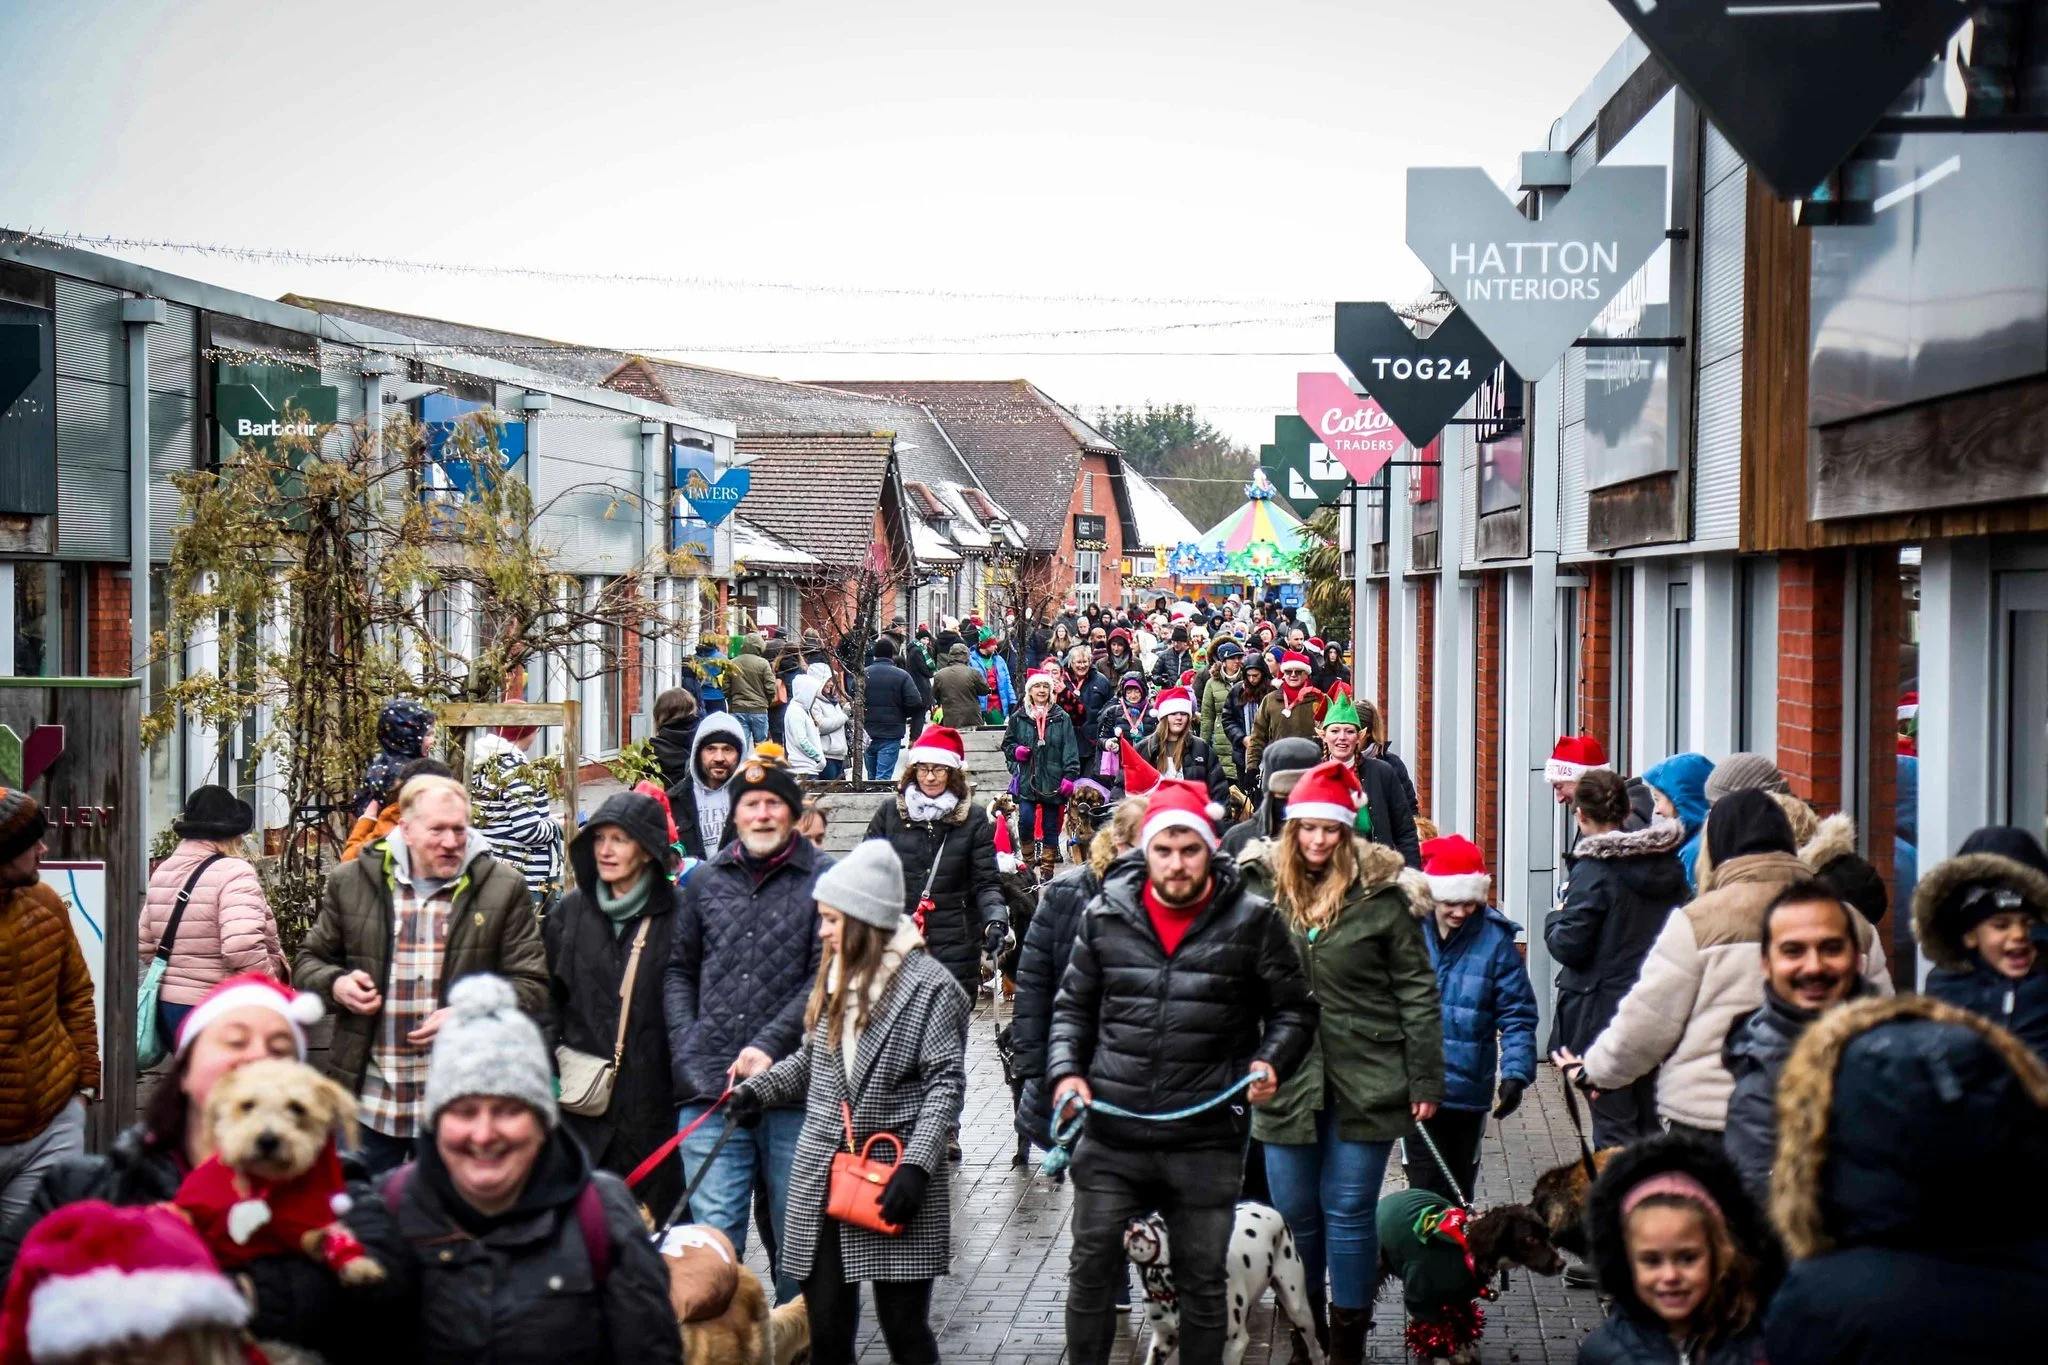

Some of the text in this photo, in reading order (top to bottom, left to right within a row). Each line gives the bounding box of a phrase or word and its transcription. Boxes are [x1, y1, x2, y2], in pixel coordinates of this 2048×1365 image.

[1450, 241, 1619, 275] HATTON
[1466, 278, 1601, 301] INTERIORS
[1371, 357, 1472, 381] TOG24
[1334, 439, 1394, 451] TRADERS
[43, 806, 115, 828] LLEY
